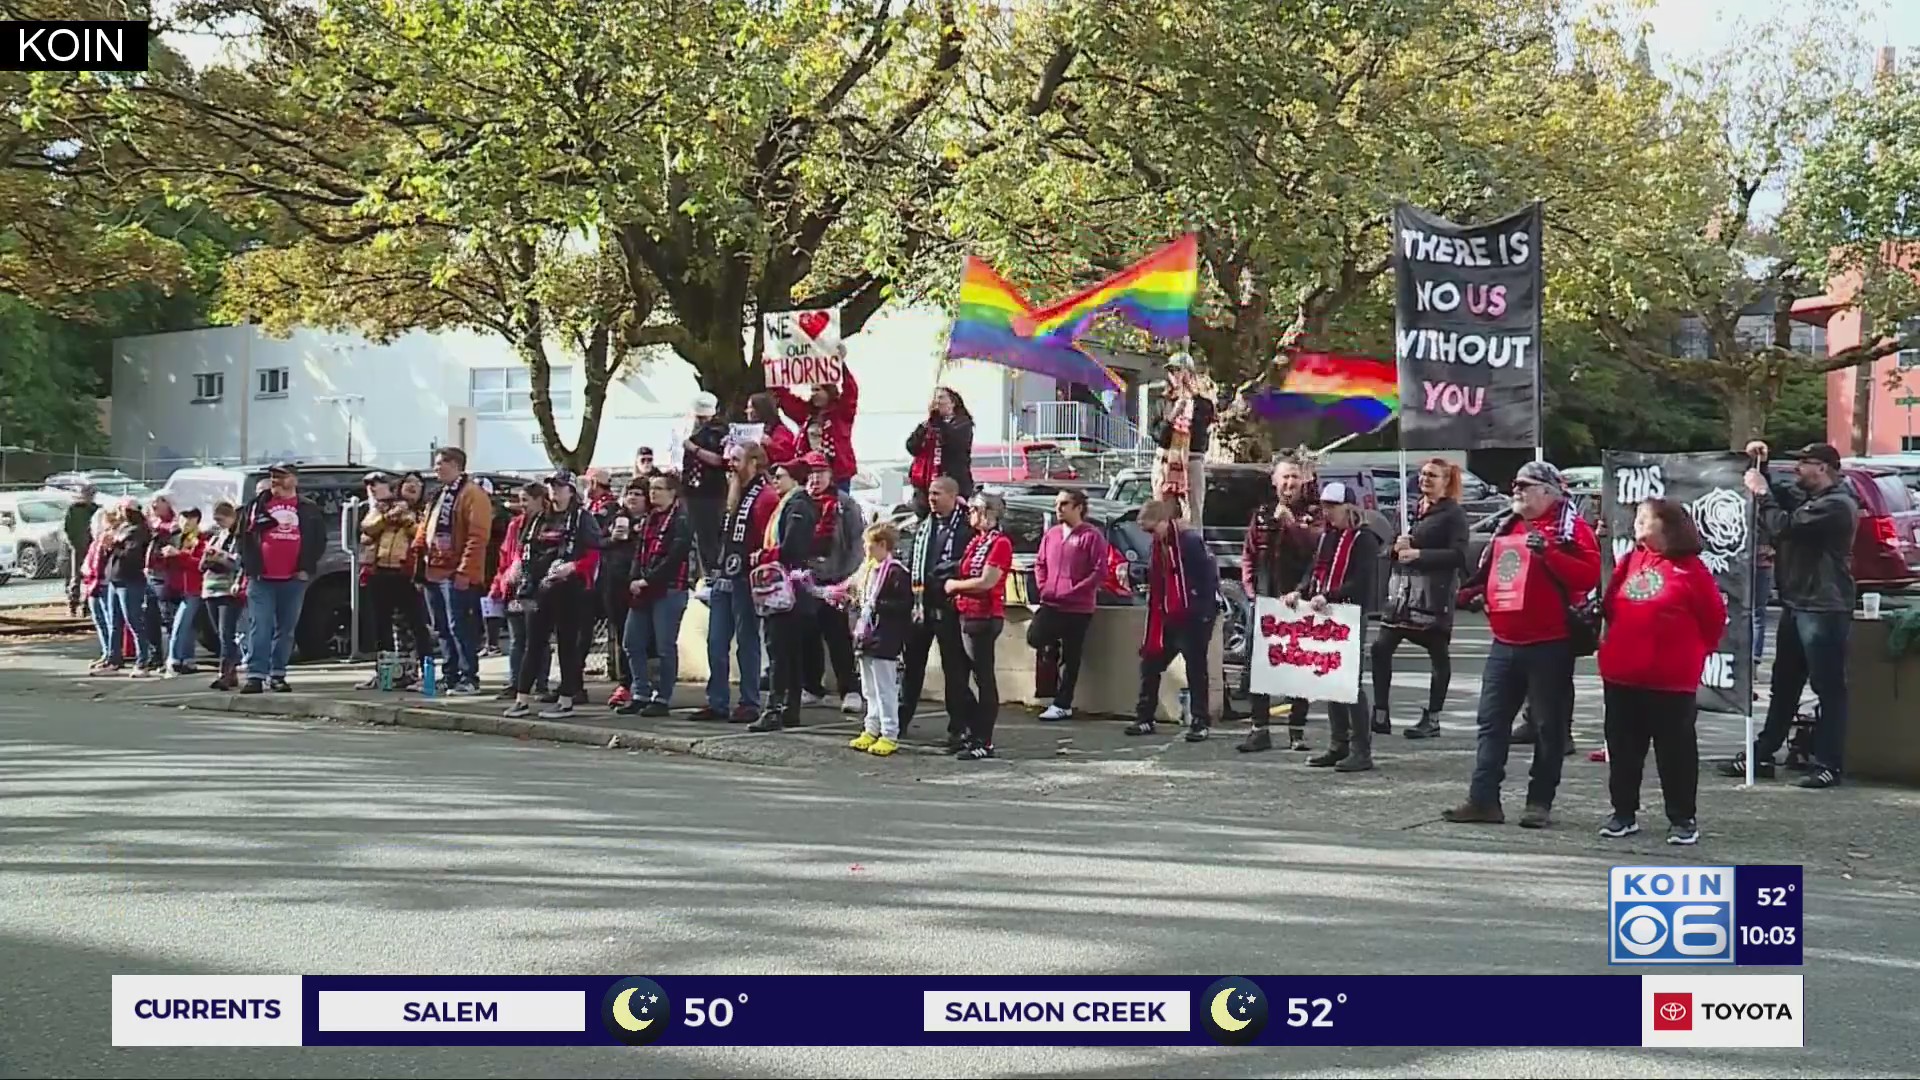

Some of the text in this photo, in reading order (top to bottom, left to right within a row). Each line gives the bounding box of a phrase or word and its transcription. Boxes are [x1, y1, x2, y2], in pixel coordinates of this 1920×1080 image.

[1401, 228, 1529, 266] THERE IS
[1415, 280, 1507, 316] NO US
[766, 315, 793, 340] WE
[1397, 328, 1531, 369] WITHOUT
[763, 355, 841, 385] THORNS
[1422, 380, 1485, 416] YOU
[1615, 465, 1666, 504] THIS
